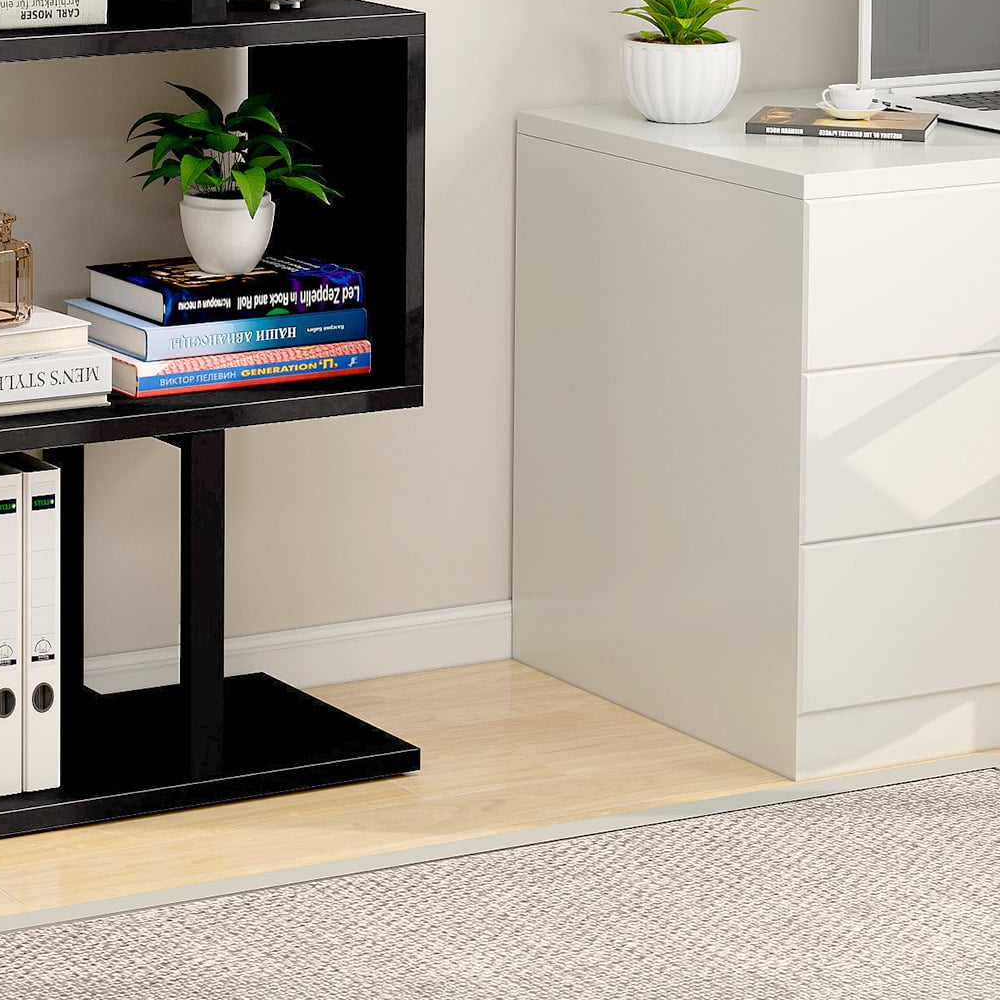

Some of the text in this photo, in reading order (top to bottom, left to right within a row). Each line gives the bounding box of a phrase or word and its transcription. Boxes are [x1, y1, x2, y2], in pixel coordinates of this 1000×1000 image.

[15, 0, 29, 10] für
[20, 8, 80, 20] CARL MOSER
[237, 284, 360, 310] Led Zeppelin in Rock and Roll
[168, 326, 297, 350] НАШИ АВИАНОСЦЫ
[240, 362, 318, 378] GENERATION
[159, 370, 237, 387] ВИКТОР ПЕЛЕВИН
